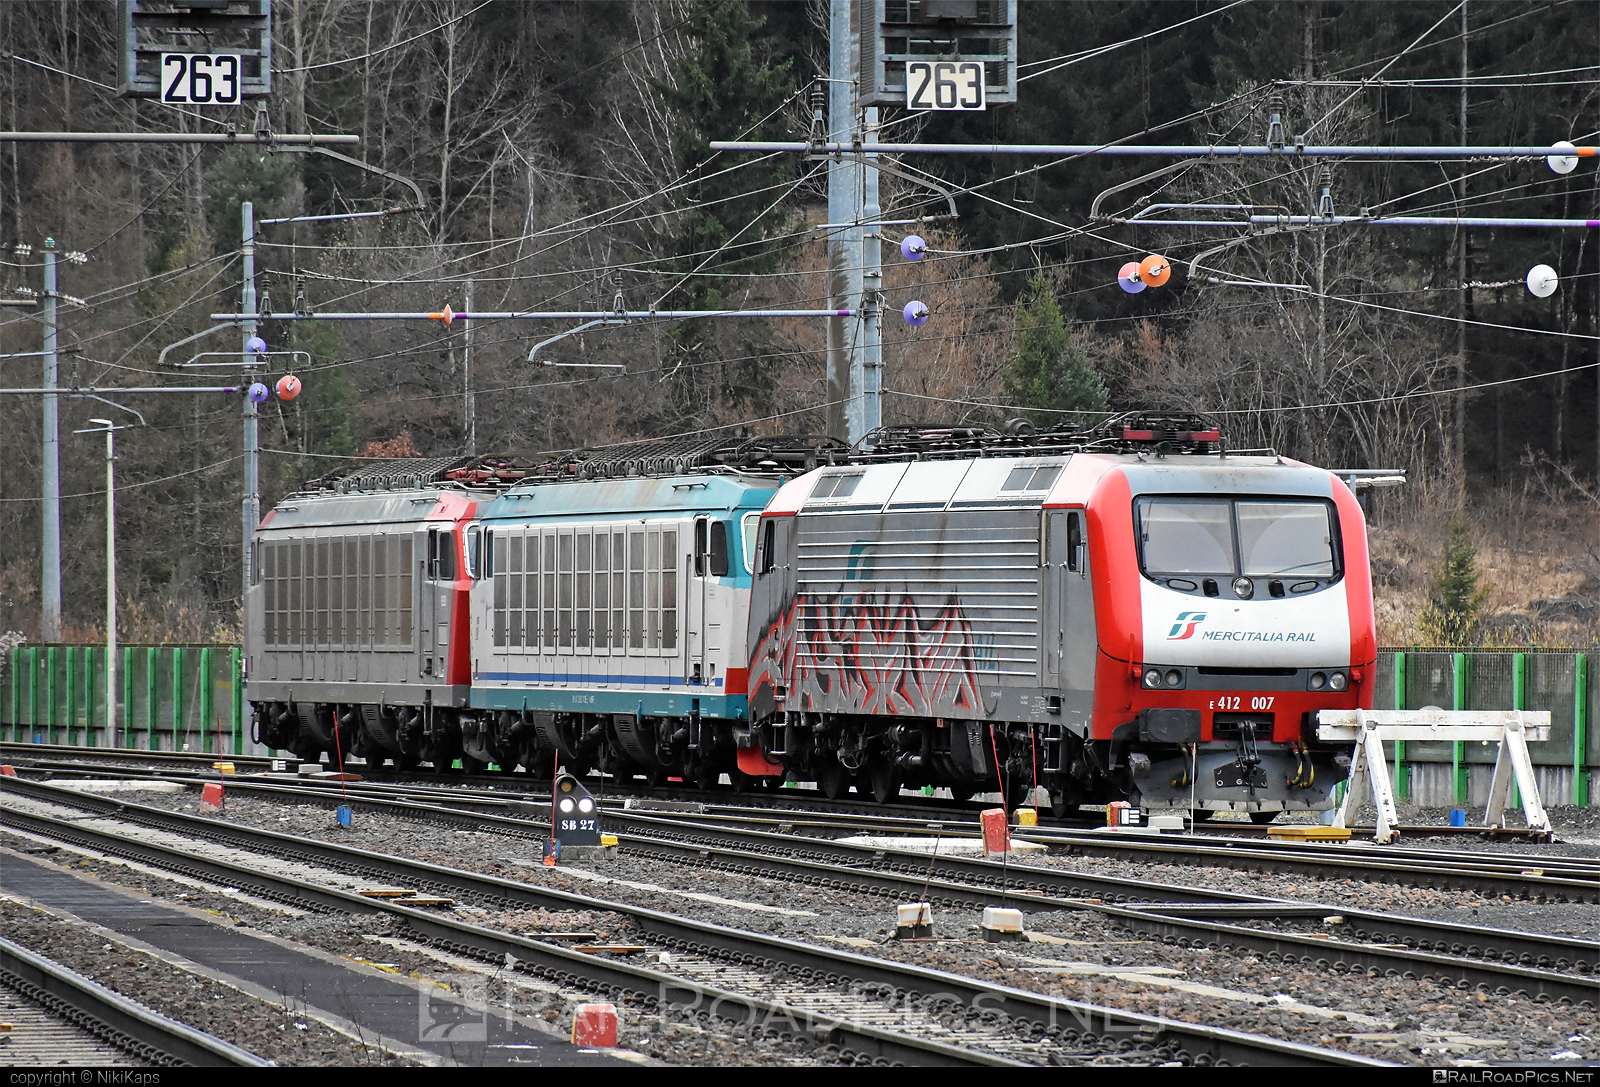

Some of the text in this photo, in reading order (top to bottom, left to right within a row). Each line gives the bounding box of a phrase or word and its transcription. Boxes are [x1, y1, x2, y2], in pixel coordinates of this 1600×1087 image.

[164, 54, 238, 103] 263
[909, 62, 982, 109] 263
[1202, 630, 1316, 643] MERCITALIA RAIL
[1209, 696, 1275, 710] E 412 007
[561, 819, 595, 831] SB 27
